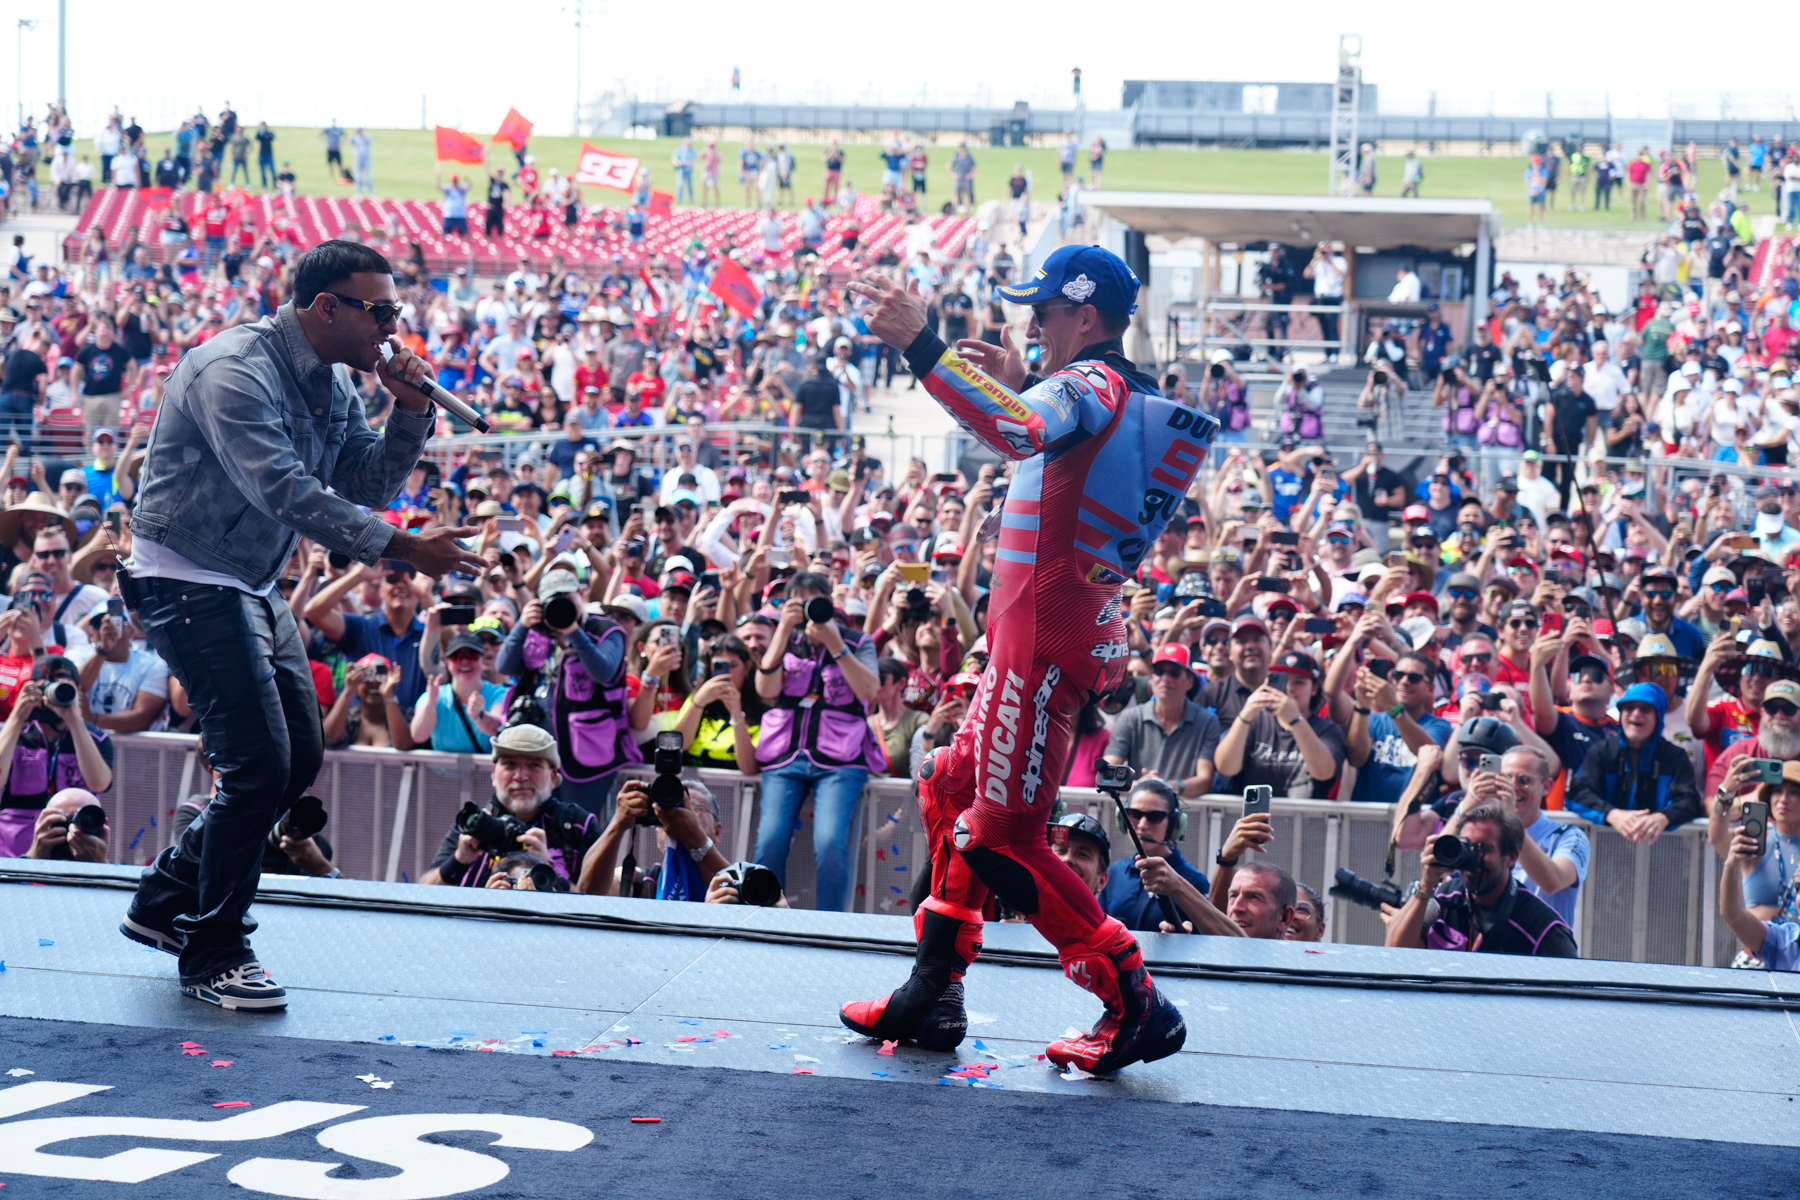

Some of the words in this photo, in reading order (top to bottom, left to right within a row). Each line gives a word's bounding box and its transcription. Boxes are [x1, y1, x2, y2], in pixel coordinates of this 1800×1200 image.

[576, 152, 640, 190] 93
[955, 361, 1027, 417] Antangin
[1150, 438, 1208, 493] 9
[985, 668, 1024, 807] DUCATI
[1021, 663, 1062, 805] alpinestars
